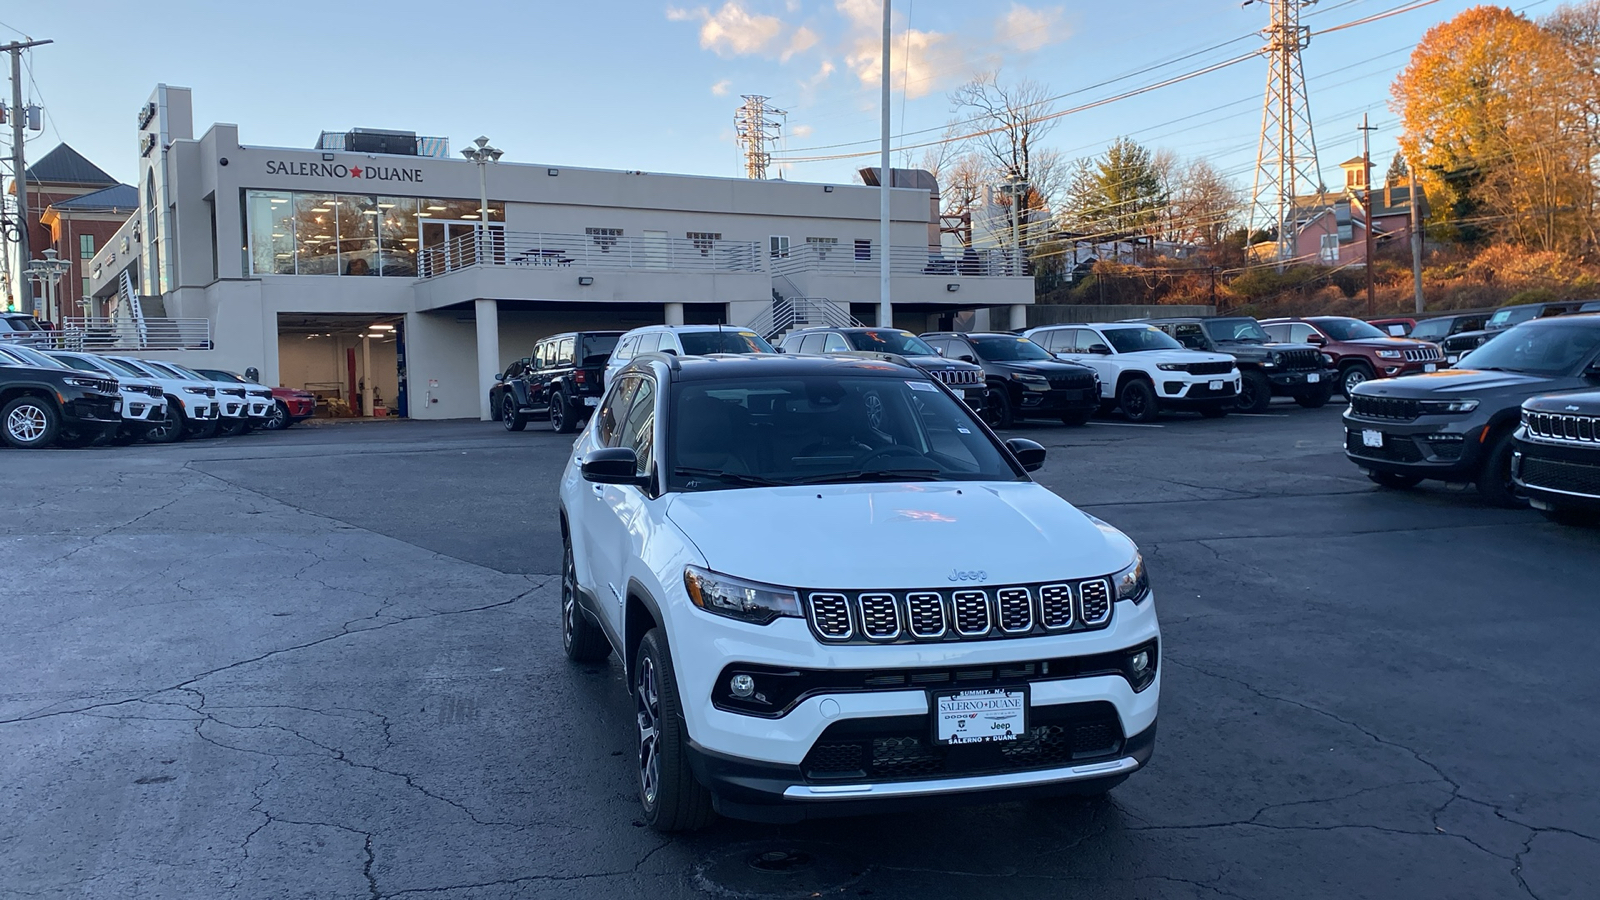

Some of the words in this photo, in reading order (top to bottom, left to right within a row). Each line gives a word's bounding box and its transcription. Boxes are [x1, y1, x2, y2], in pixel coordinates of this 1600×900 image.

[266, 160, 348, 178] SALERNO
[365, 166, 423, 182] DUANE
[947, 569, 987, 582] Jeep
[940, 701, 983, 711] SALERNO
[988, 699, 1021, 709] DUANE
[991, 722, 1010, 730] Jeep
[948, 737, 983, 745] SALERNO
[993, 734, 1017, 742] DUANE
